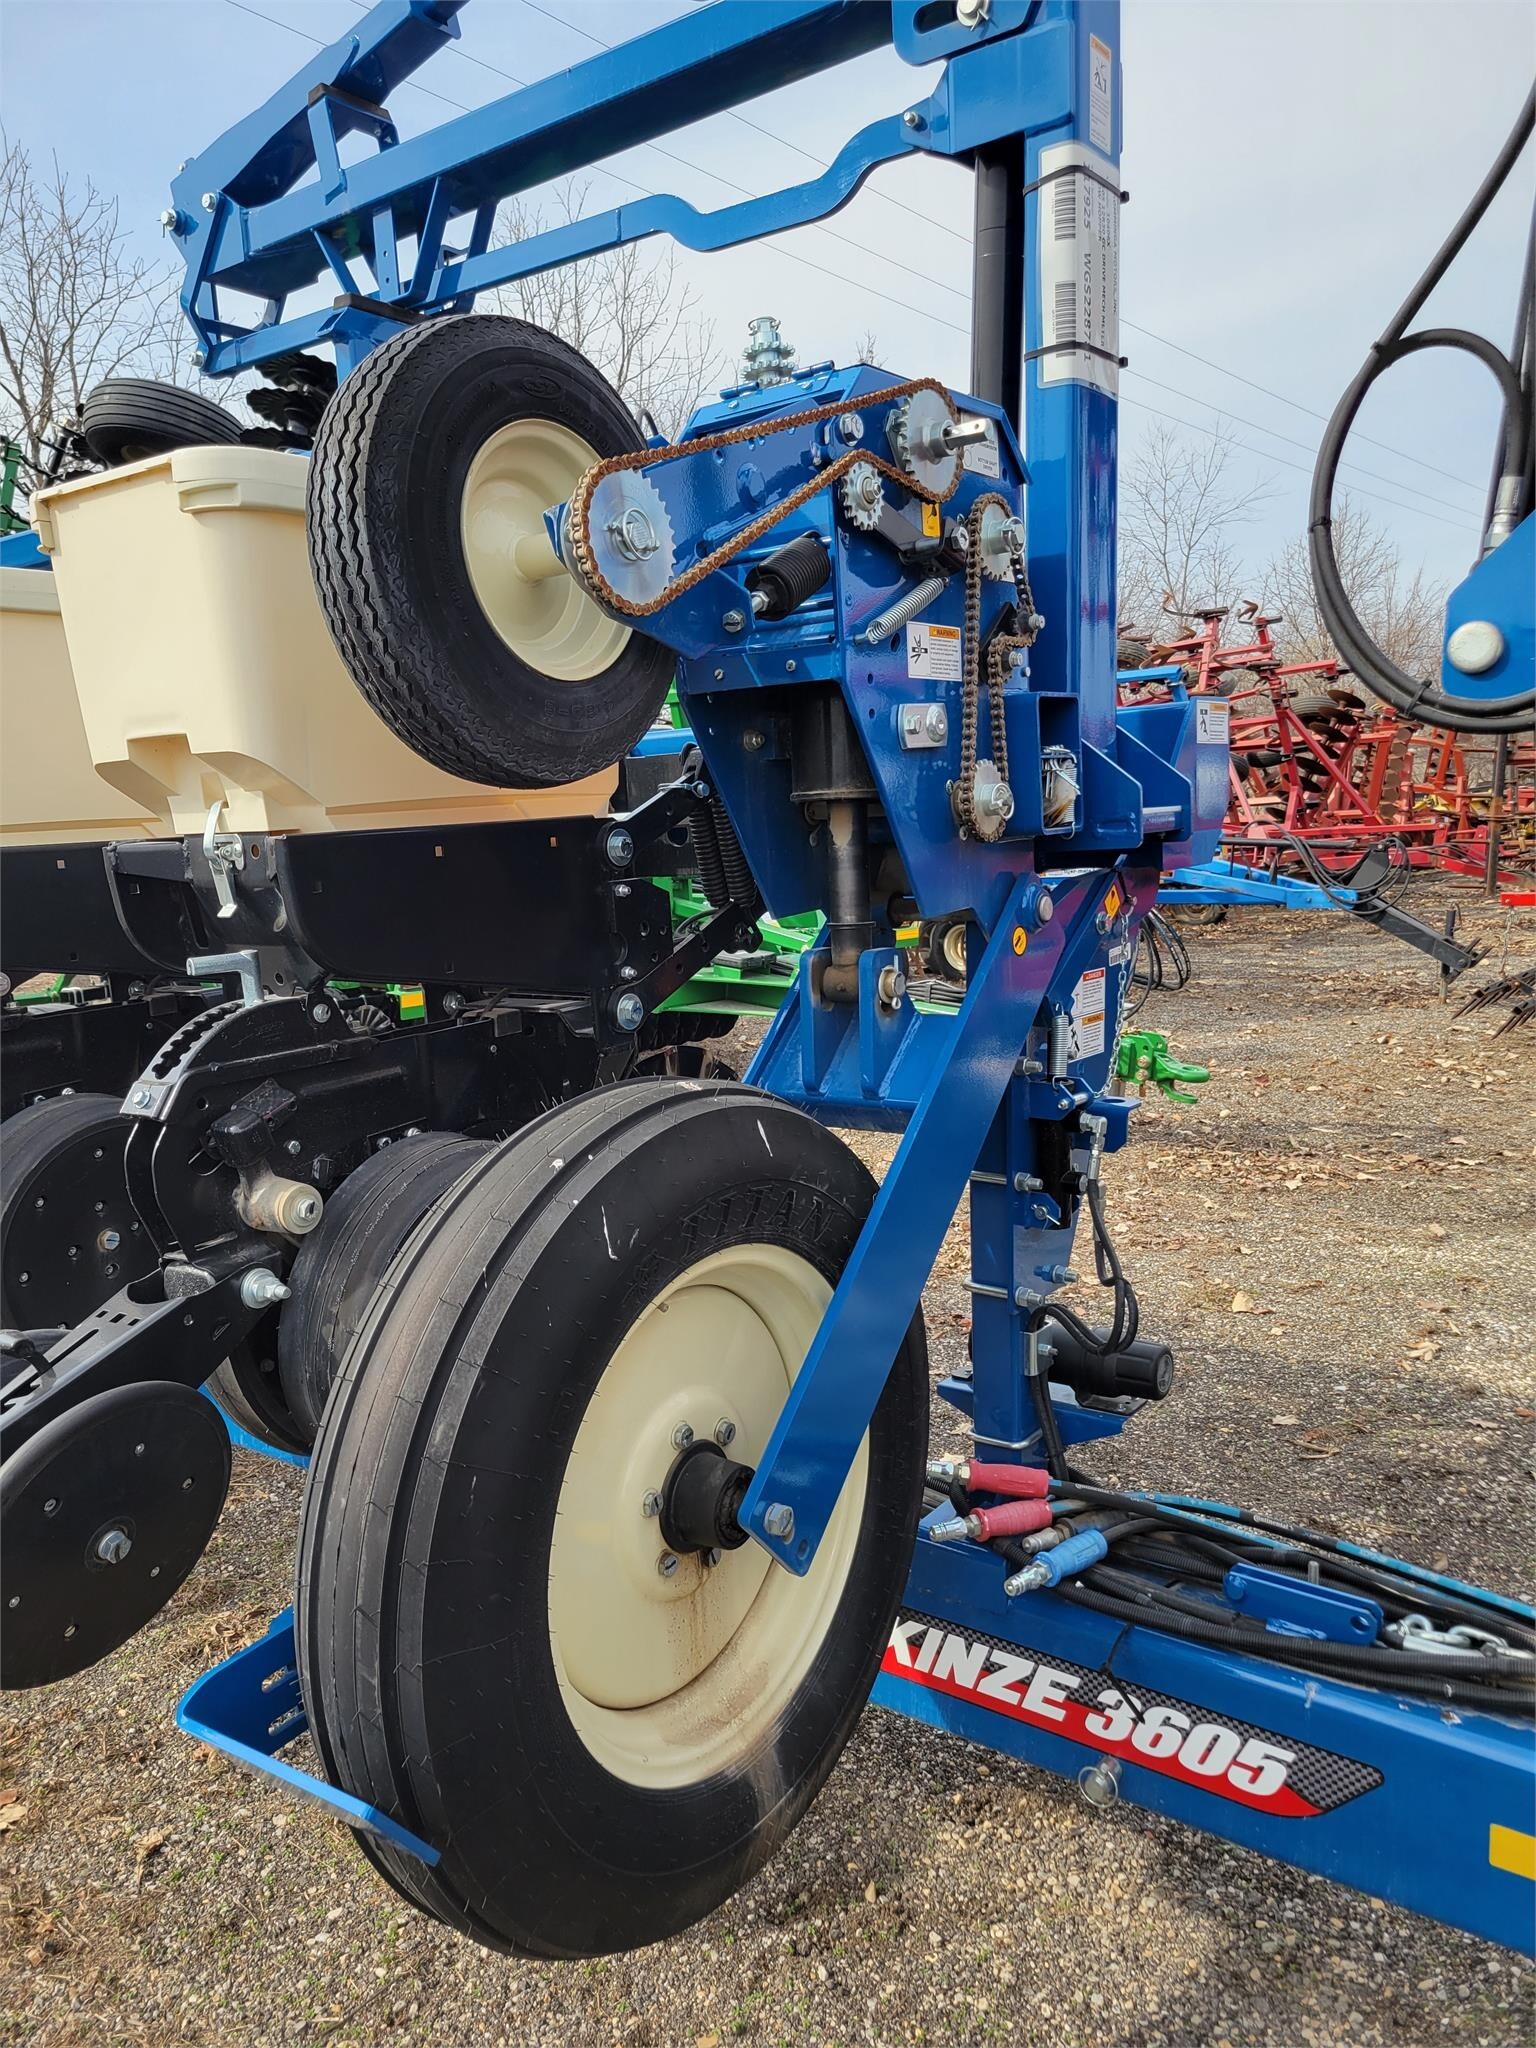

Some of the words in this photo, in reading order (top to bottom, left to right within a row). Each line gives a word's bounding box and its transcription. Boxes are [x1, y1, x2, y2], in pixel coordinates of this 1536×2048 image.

[1083, 252, 1092, 362] WGS22871
[680, 1184, 838, 1258] TITAN
[886, 1615, 1081, 1722] KINZE
[1085, 1690, 1297, 1797] 3605
